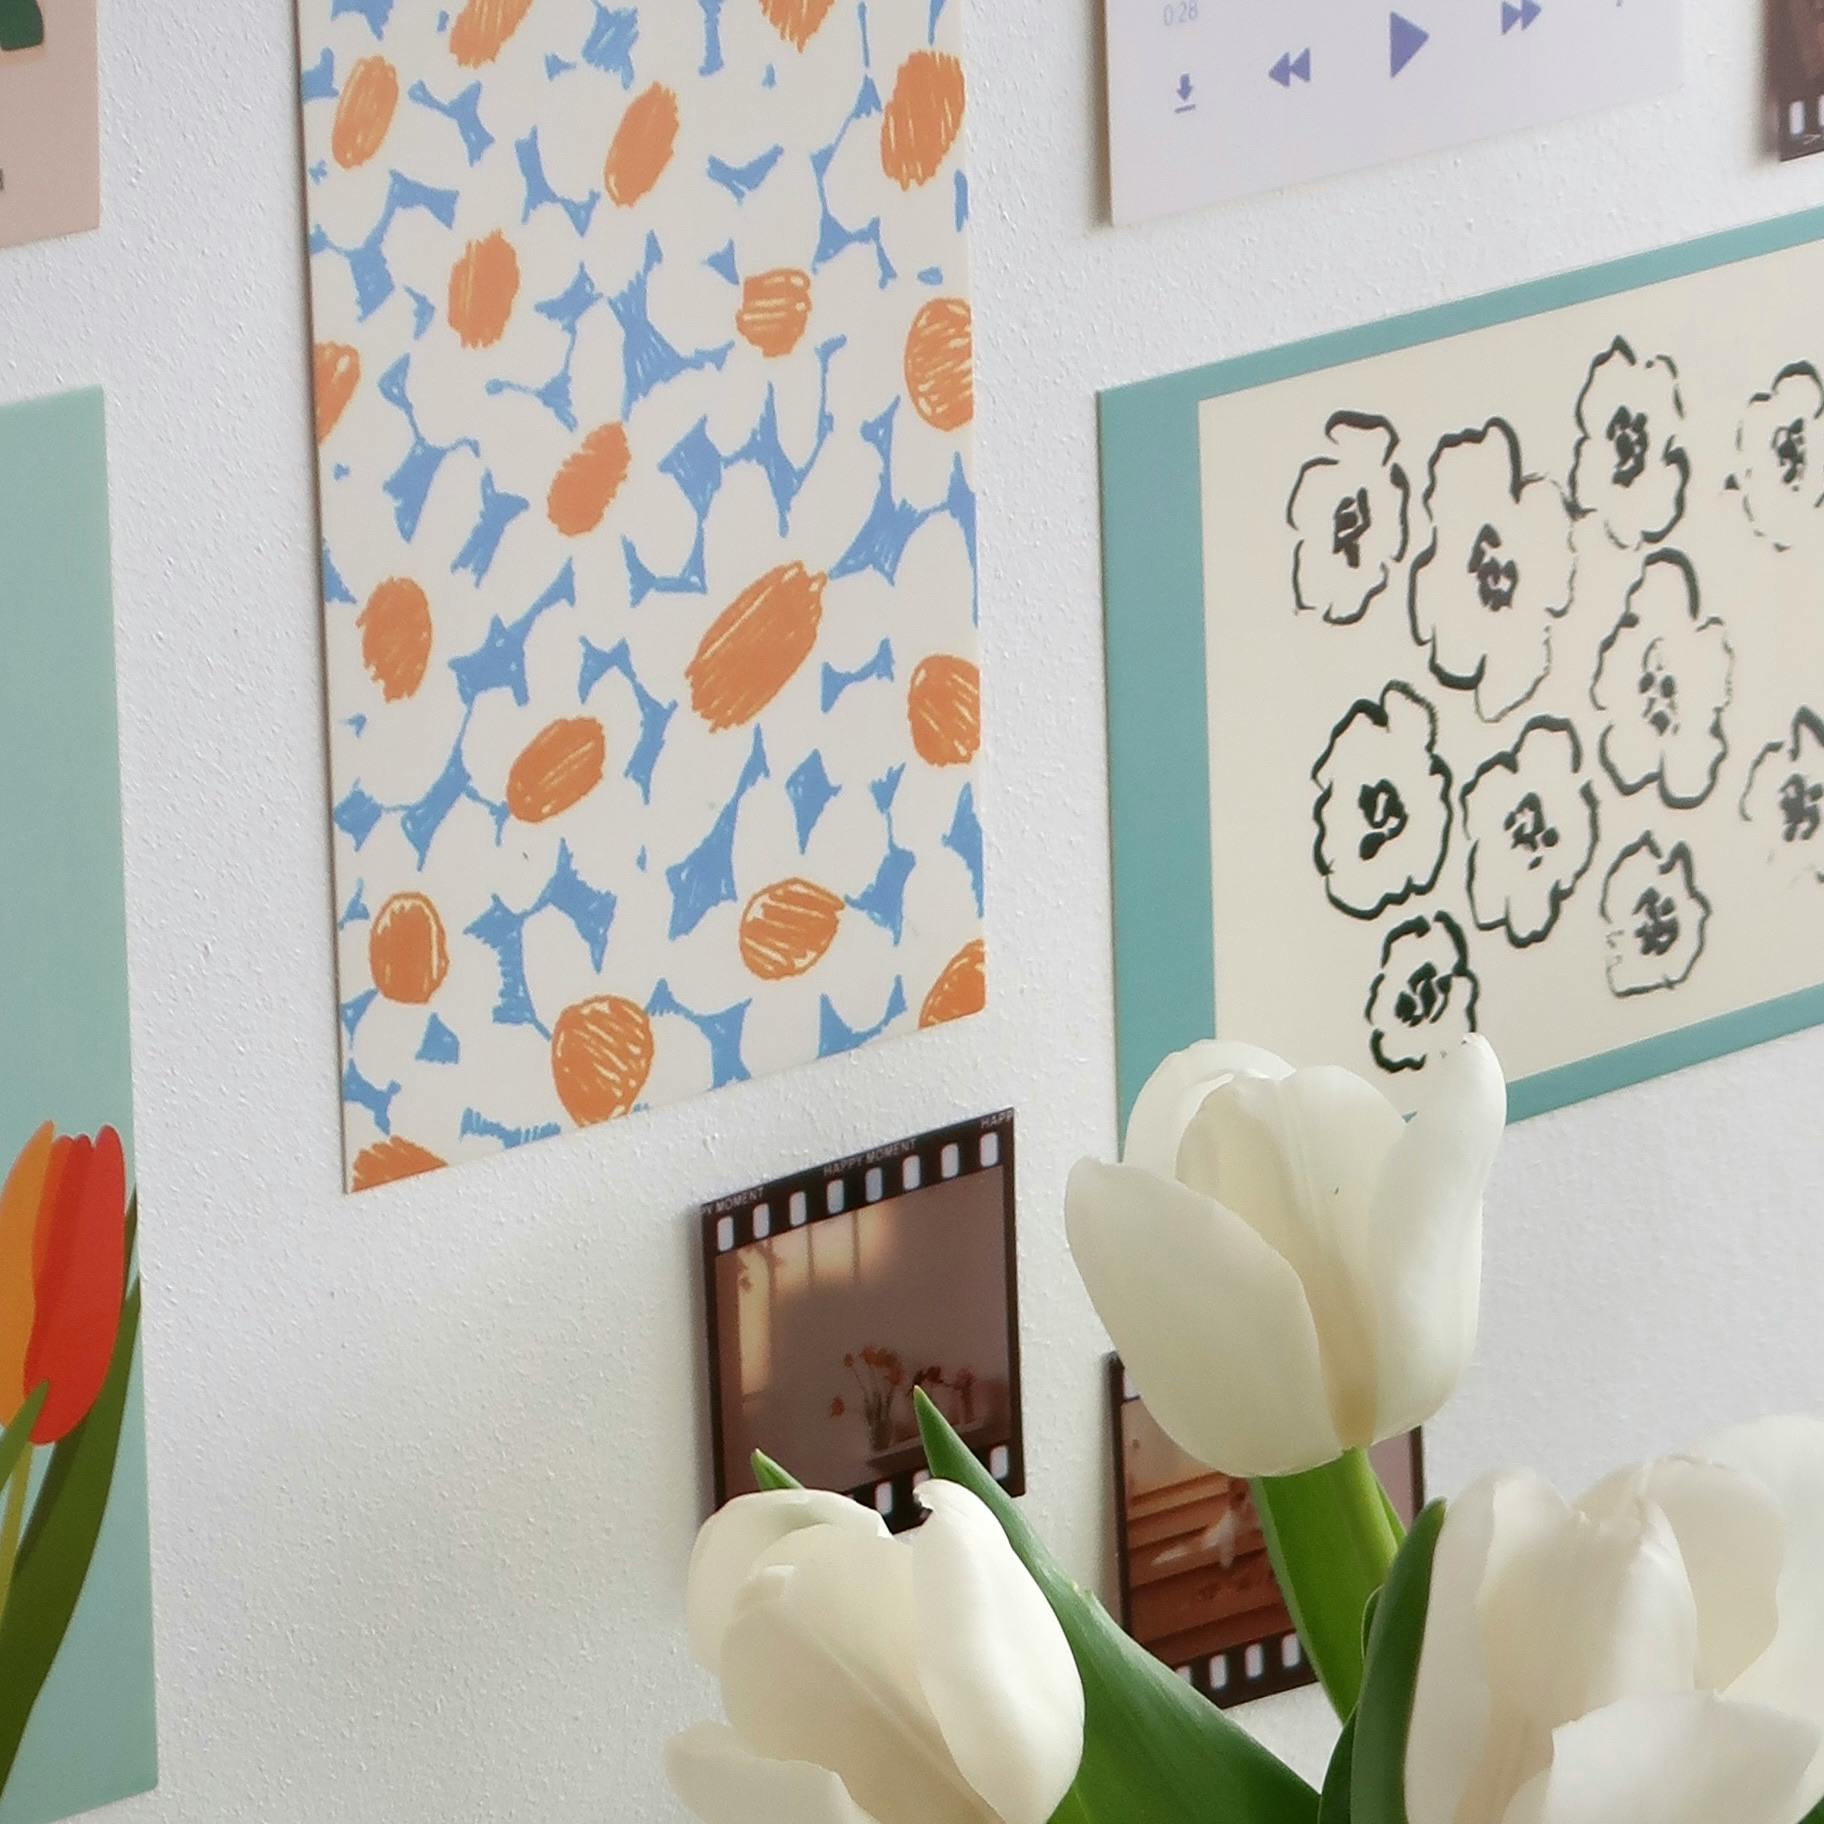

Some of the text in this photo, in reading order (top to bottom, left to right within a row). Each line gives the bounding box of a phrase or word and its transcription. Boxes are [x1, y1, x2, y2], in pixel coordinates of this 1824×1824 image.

[823, 1139, 917, 1177] HAPPY MOMENT
[715, 1186, 765, 1213] MOMENT
